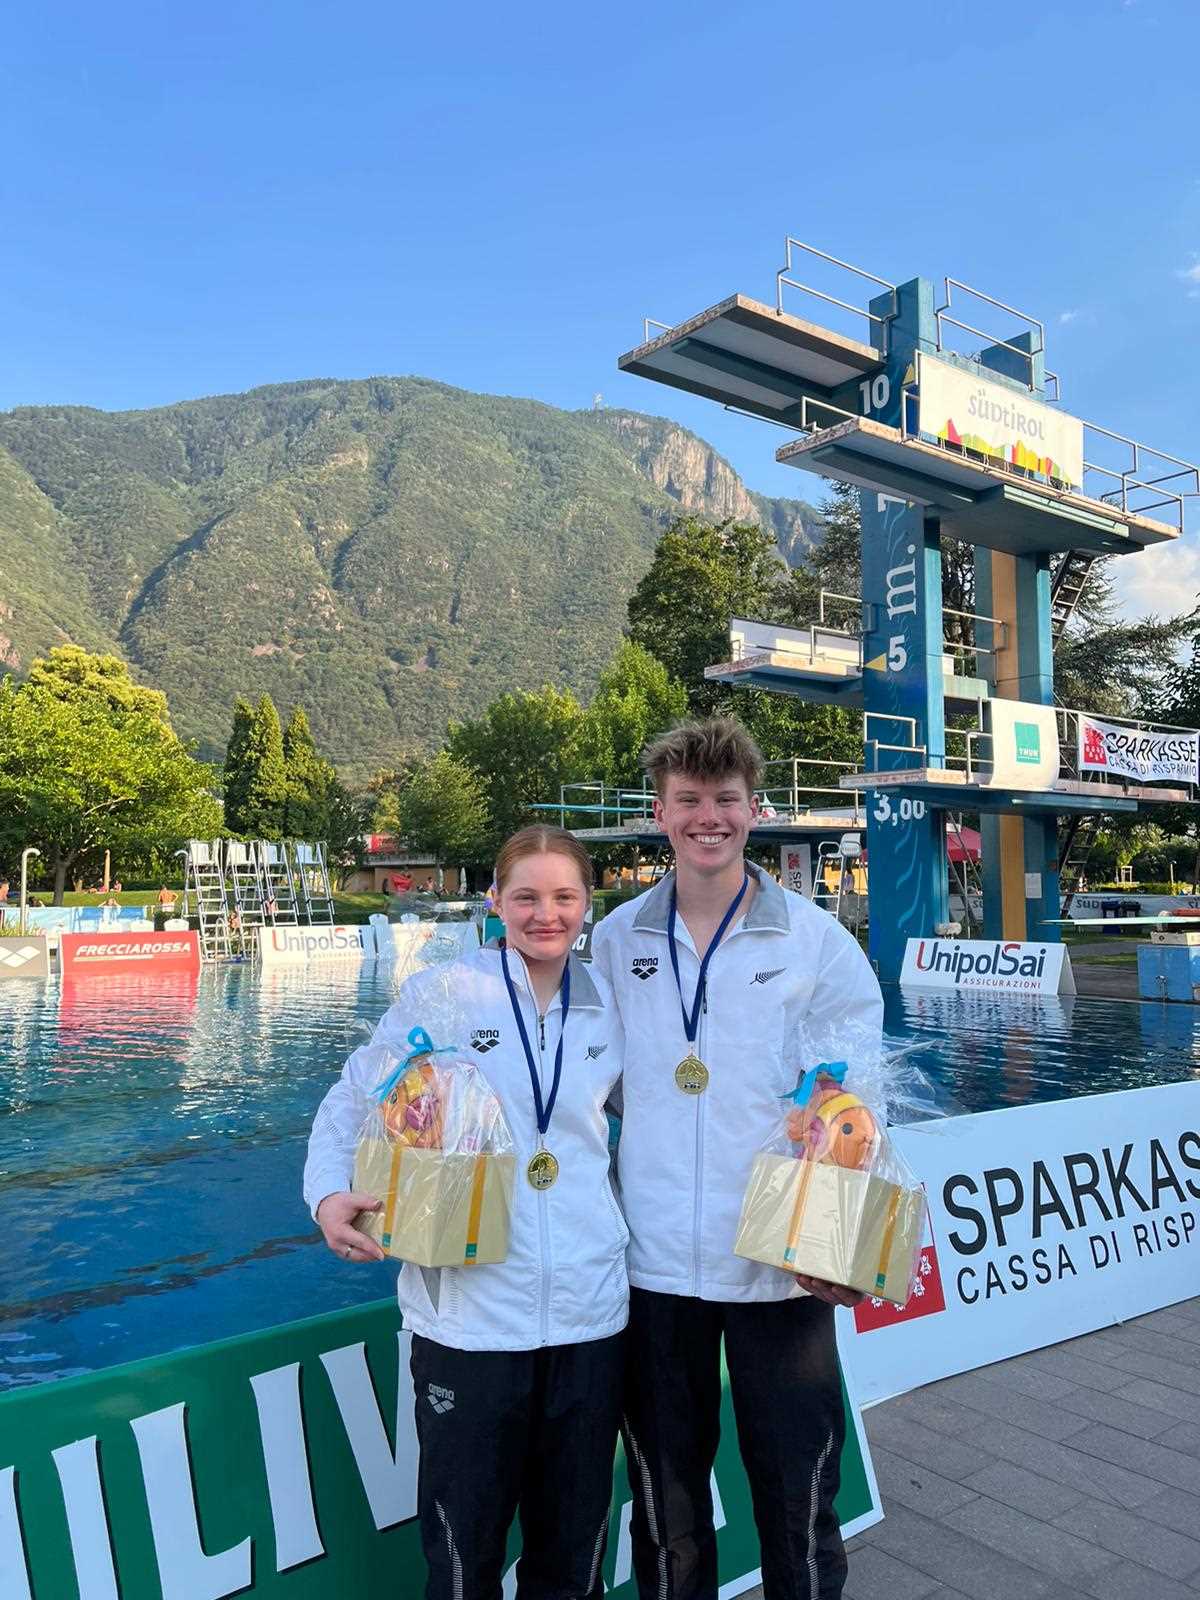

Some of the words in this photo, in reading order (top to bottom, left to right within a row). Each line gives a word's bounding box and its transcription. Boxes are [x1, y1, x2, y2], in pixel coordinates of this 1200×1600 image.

[859, 374, 890, 415] 10
[888, 634, 908, 672] 5
[1105, 732, 1197, 763] SPARKASSE
[873, 791, 926, 827] 3,00
[75, 942, 191, 956] FRECCIAROSSA
[272, 928, 364, 958] UnipolSai
[632, 957, 659, 967] arena
[916, 941, 1047, 983] UnipolSai
[962, 978, 1042, 990] ASSICURAZIONI
[470, 1029, 500, 1039] arena
[956, 1243, 1078, 1305] CASSA
[1088, 1230, 1121, 1269] DI
[1132, 1211, 1196, 1257] RISP
[428, 1383, 455, 1401] arena
